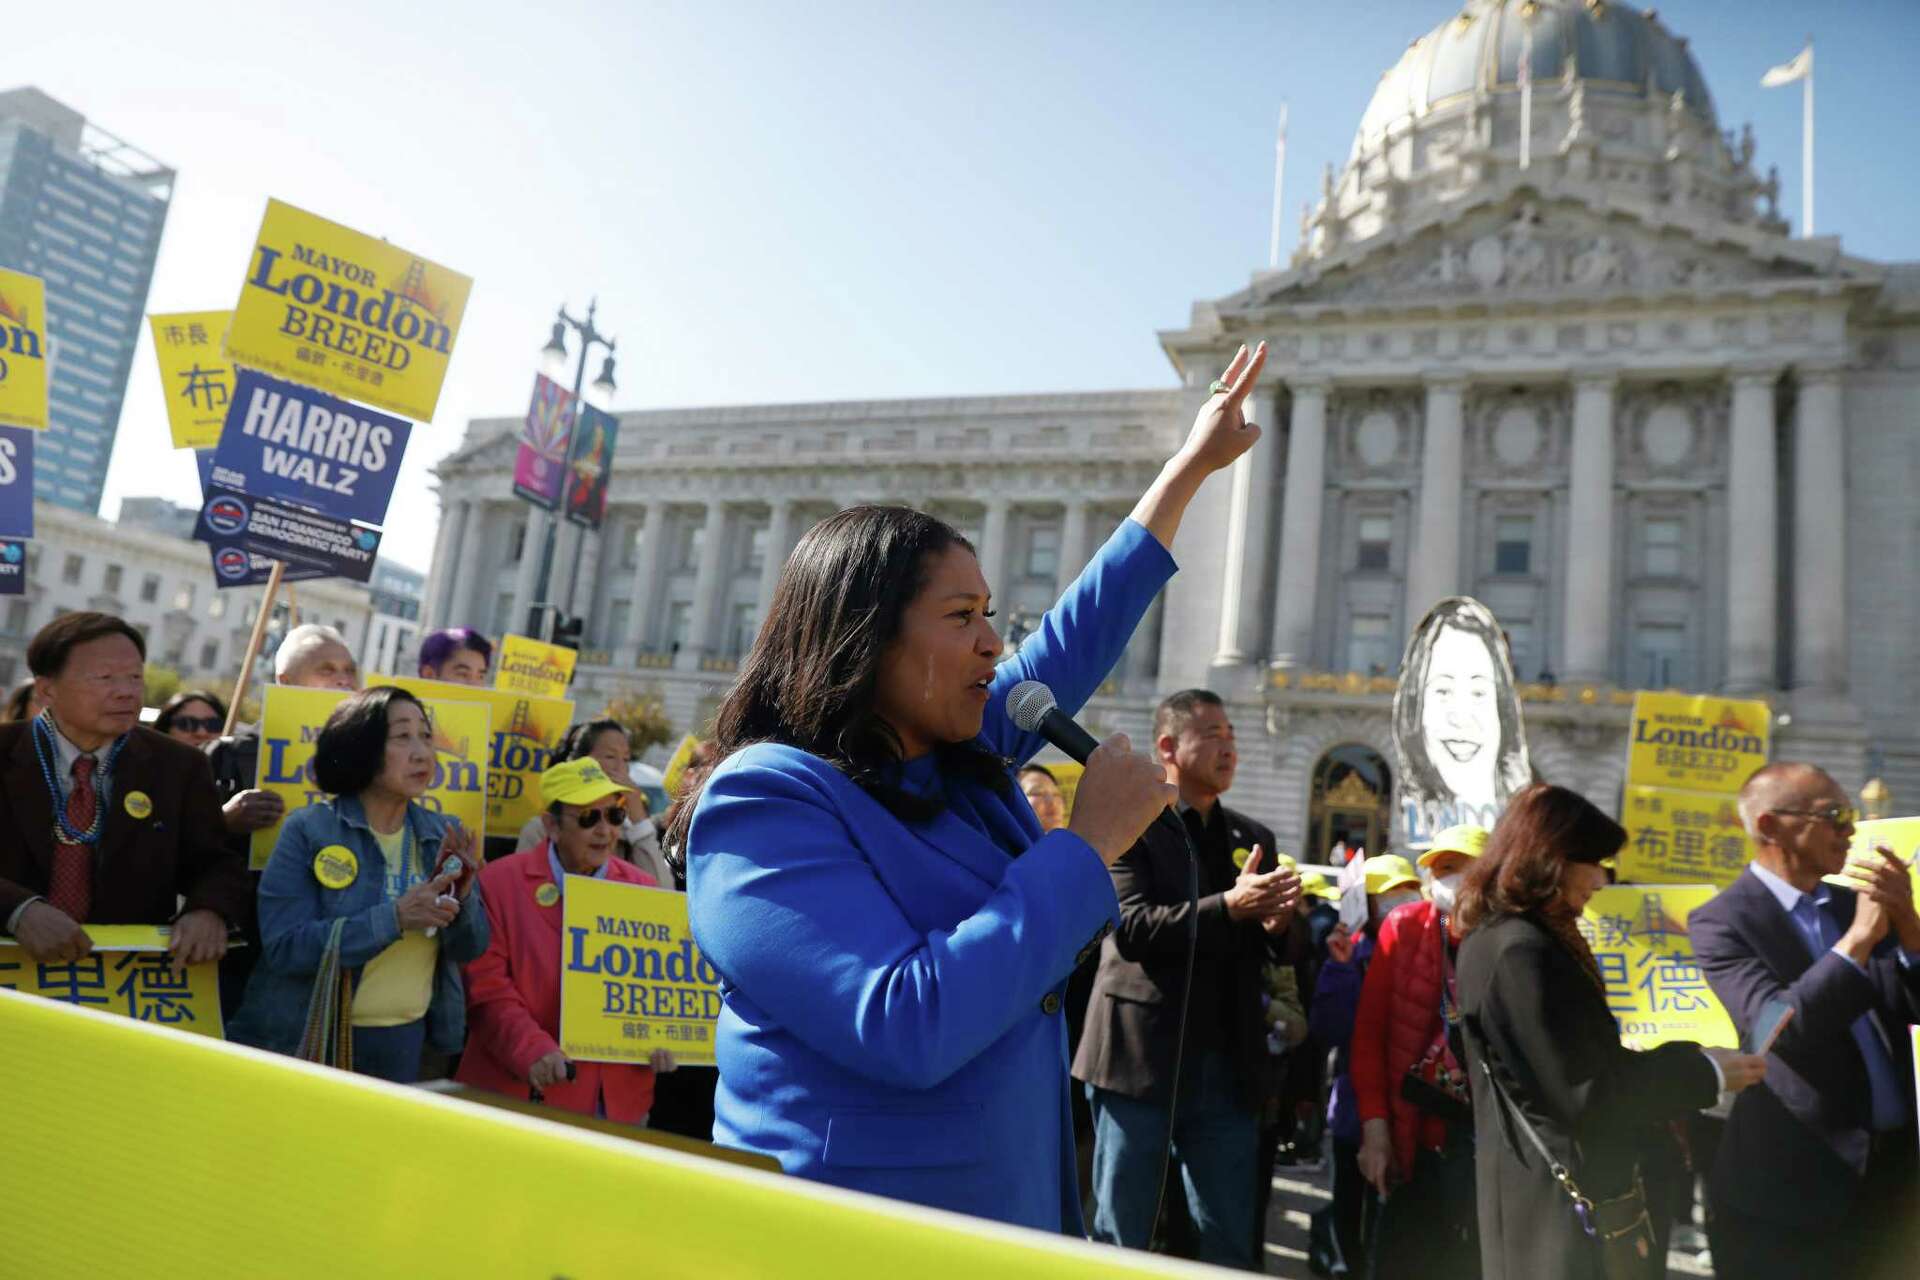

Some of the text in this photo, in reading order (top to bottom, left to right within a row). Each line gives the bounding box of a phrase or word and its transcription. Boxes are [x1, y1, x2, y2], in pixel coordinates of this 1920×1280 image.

[290, 243, 376, 288] MAYOR
[250, 245, 451, 354] London
[279, 304, 411, 371] BREED
[243, 387, 393, 472] HARRIS
[262, 446, 359, 496] WALZ
[1634, 719, 1763, 755] London
[597, 916, 671, 943] MAYOR
[568, 926, 723, 986] Londo
[602, 980, 723, 1021] BREED
